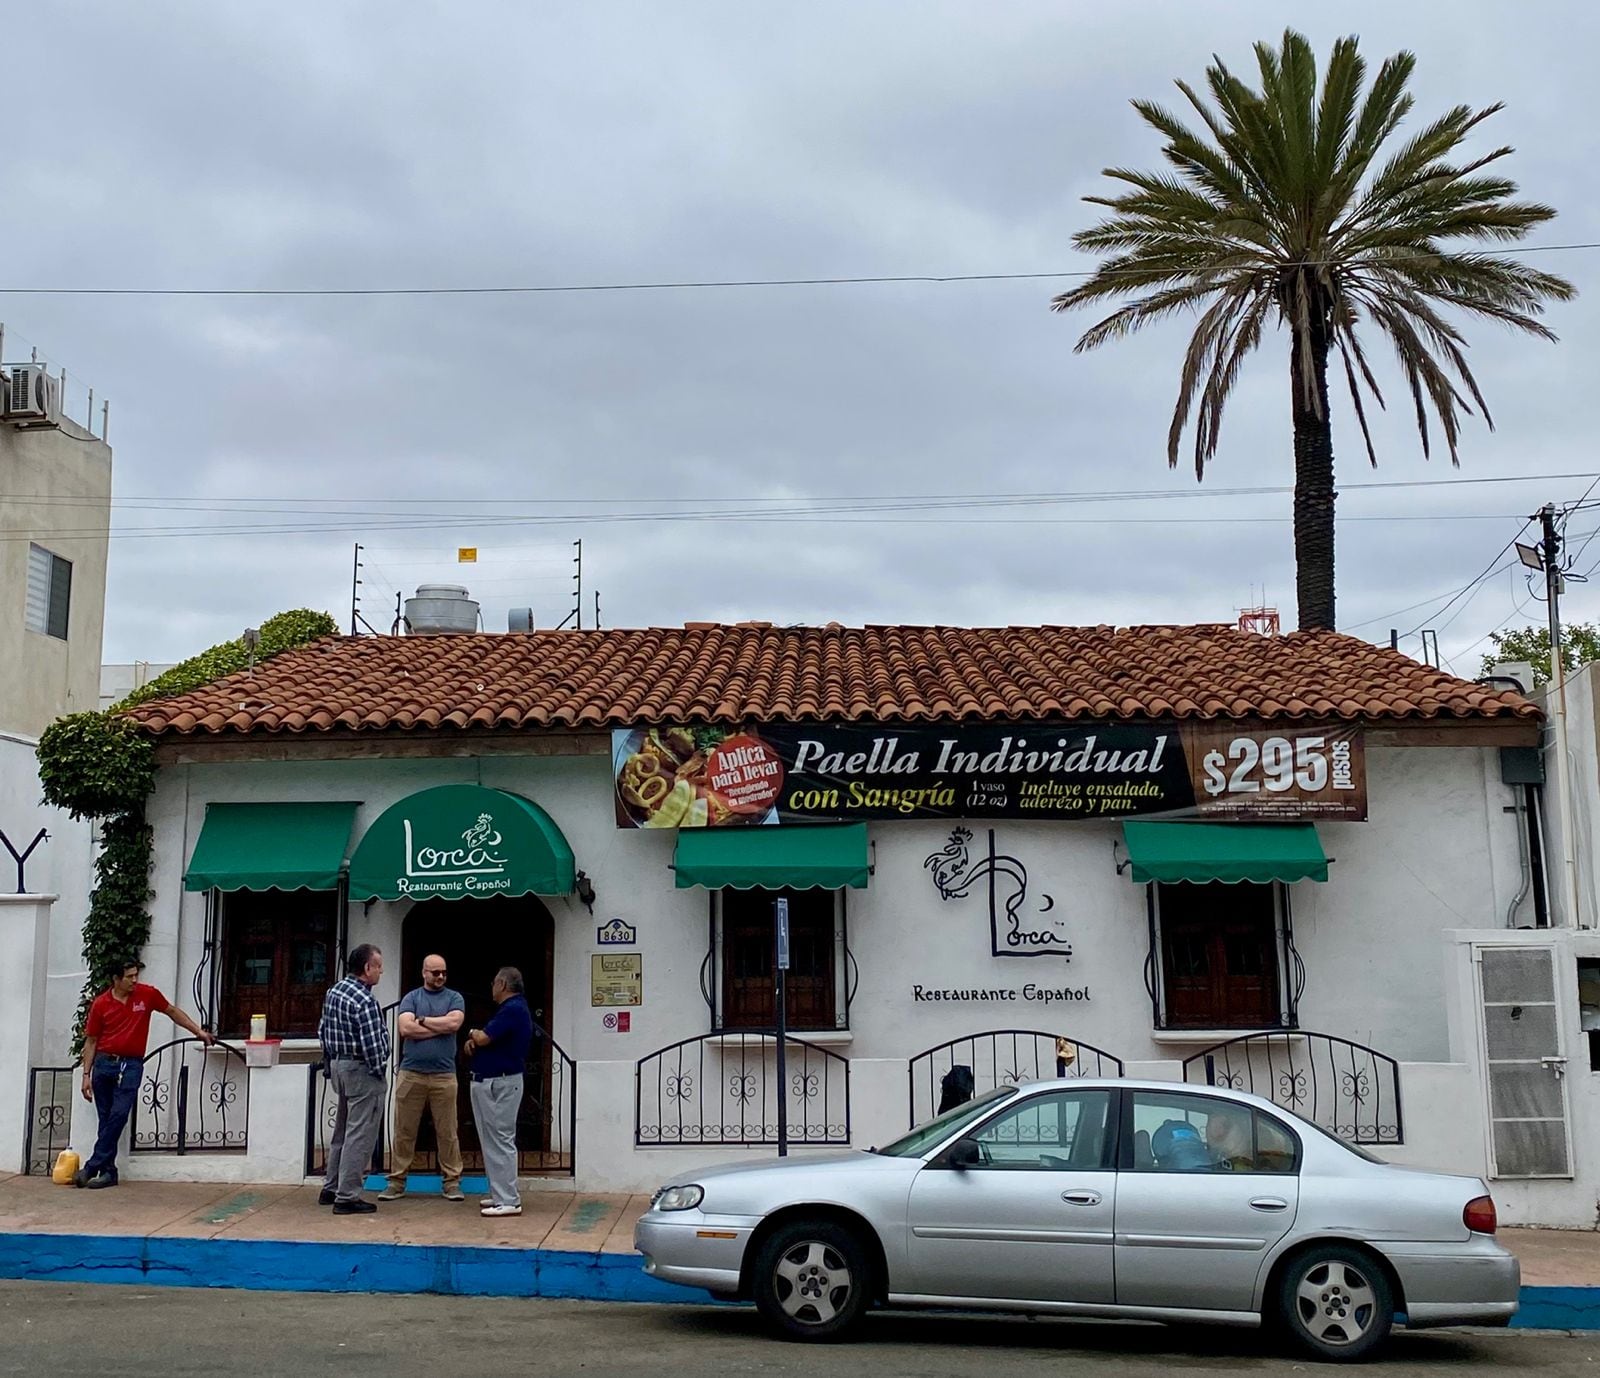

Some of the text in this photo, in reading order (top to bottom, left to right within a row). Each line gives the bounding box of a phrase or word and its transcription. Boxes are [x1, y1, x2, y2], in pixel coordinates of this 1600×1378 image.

[717, 746, 766, 771] Aplica
[788, 734, 1167, 775] Paella Individual
[1203, 737, 1328, 796] $295
[1332, 740, 1356, 790] pesos
[711, 761, 778, 791] para llevar
[972, 780, 1005, 792] 1 vaso
[789, 780, 956, 813] con Sangría
[966, 794, 1008, 808] (12 oz)
[1019, 780, 1165, 799] Incluye ensalada,
[1020, 795, 1137, 813] aderezo y pan.
[403, 819, 509, 877] Lorca
[396, 876, 511, 893] Restaurante Español
[988, 829, 1073, 957] Lorca
[603, 930, 630, 941] 8630
[912, 983, 1091, 1005] Restaurante Español
